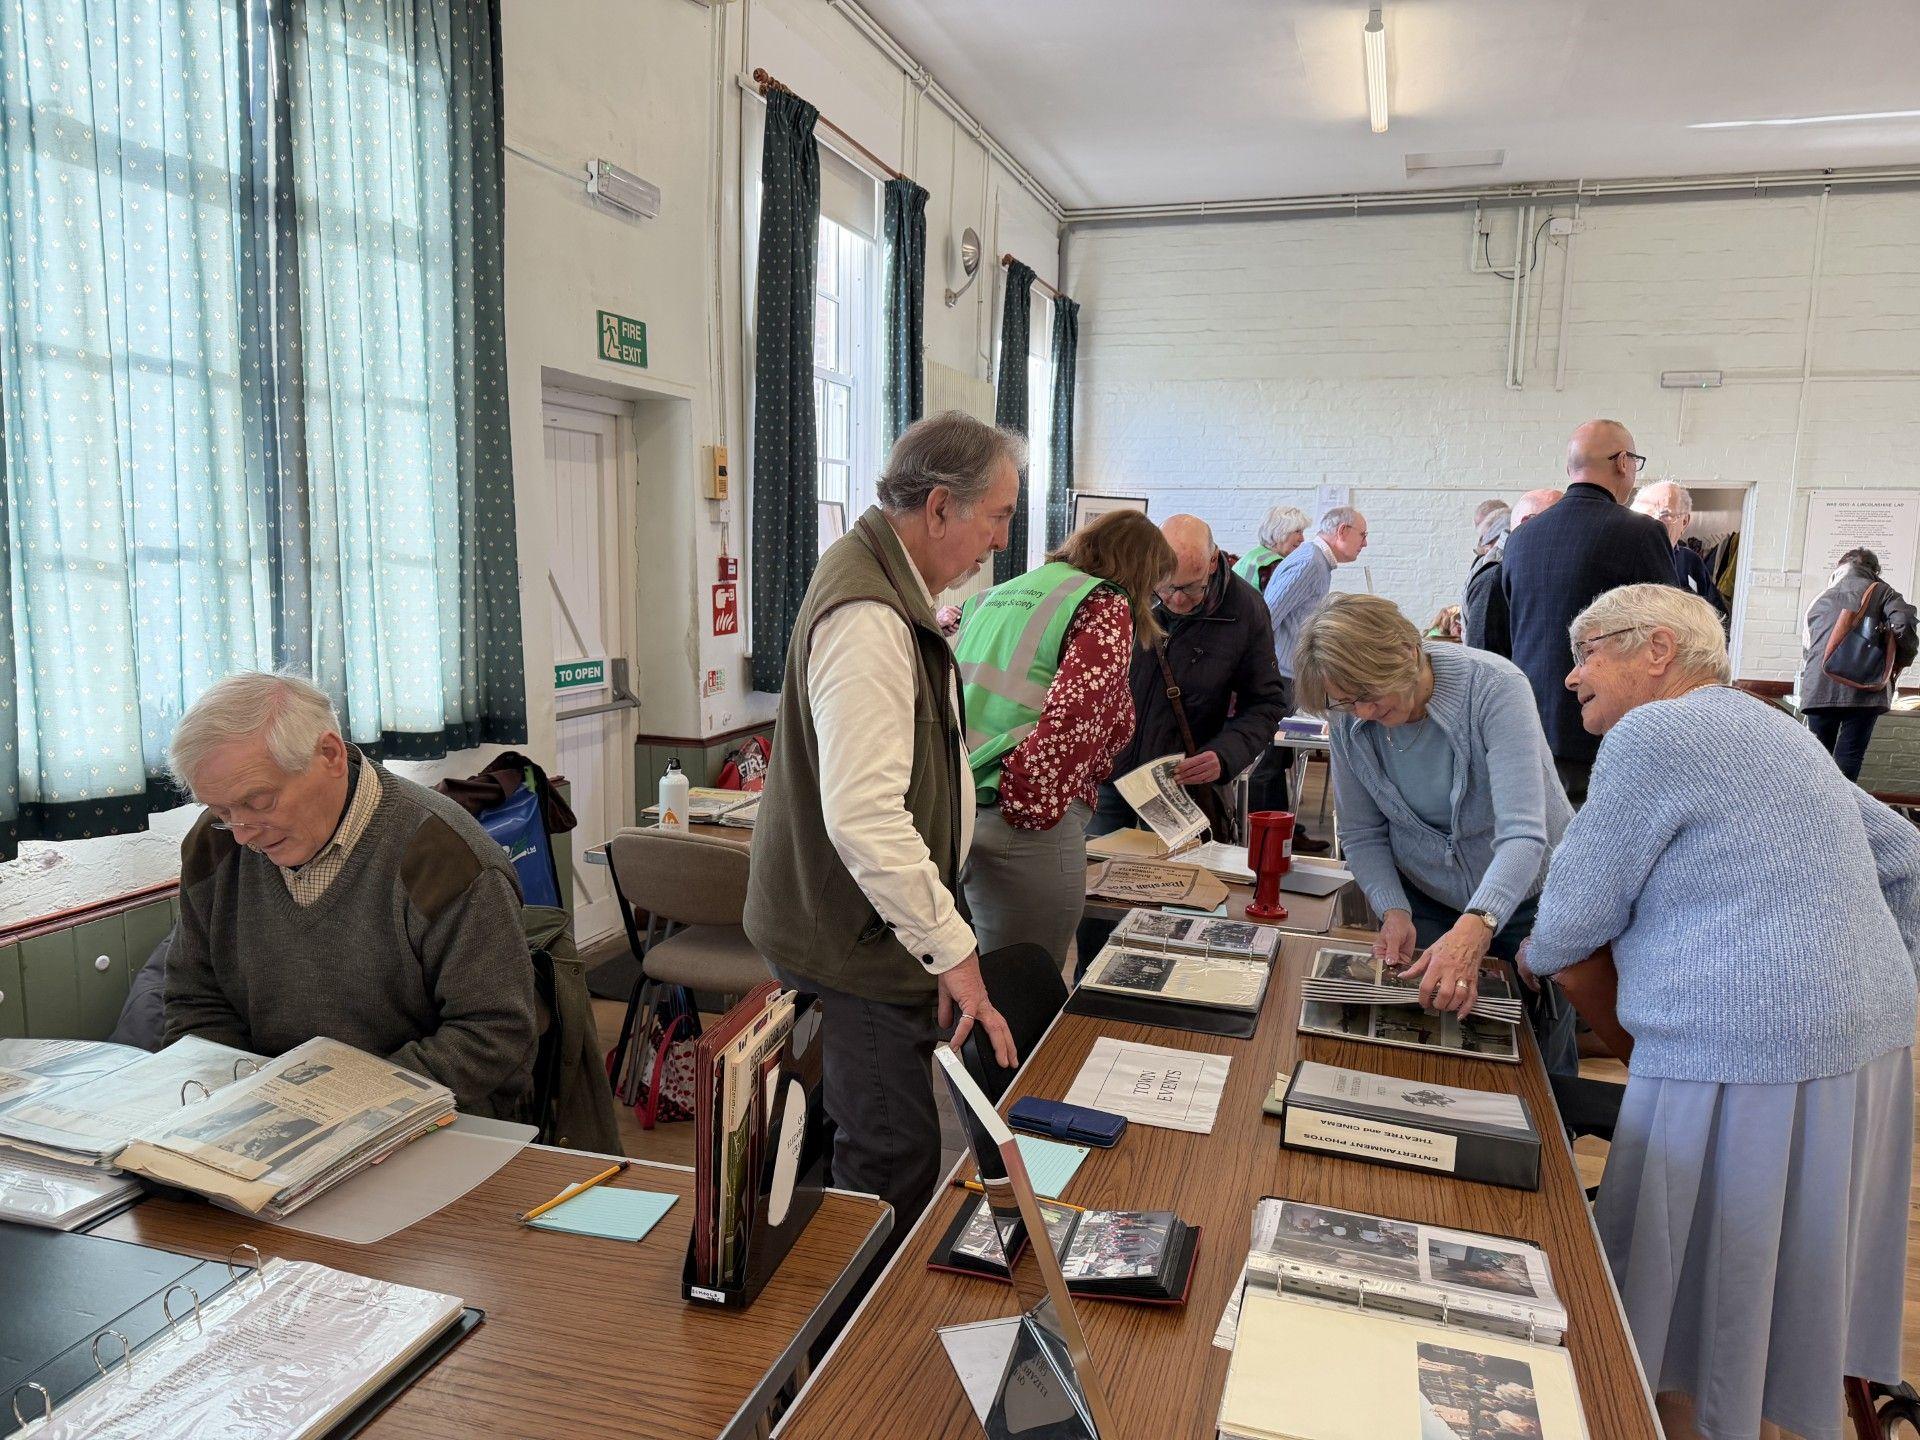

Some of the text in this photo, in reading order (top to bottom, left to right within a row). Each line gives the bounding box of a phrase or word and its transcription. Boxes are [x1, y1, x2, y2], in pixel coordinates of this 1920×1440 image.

[621, 321, 642, 342] FIRE
[622, 345, 642, 364] EXIT
[1008, 599, 1035, 610] Society
[559, 665, 601, 682] TO OPEN
[737, 754, 768, 778] FIRE
[527, 845, 536, 854] Ltd
[1132, 1069, 1157, 1096] TOWN
[1156, 1068, 1183, 1103] EVENTS
[1320, 1119, 1433, 1145] THEATRE and CINEMA
[1303, 1133, 1439, 1163] ENTERTAINMENT PHOTOS
